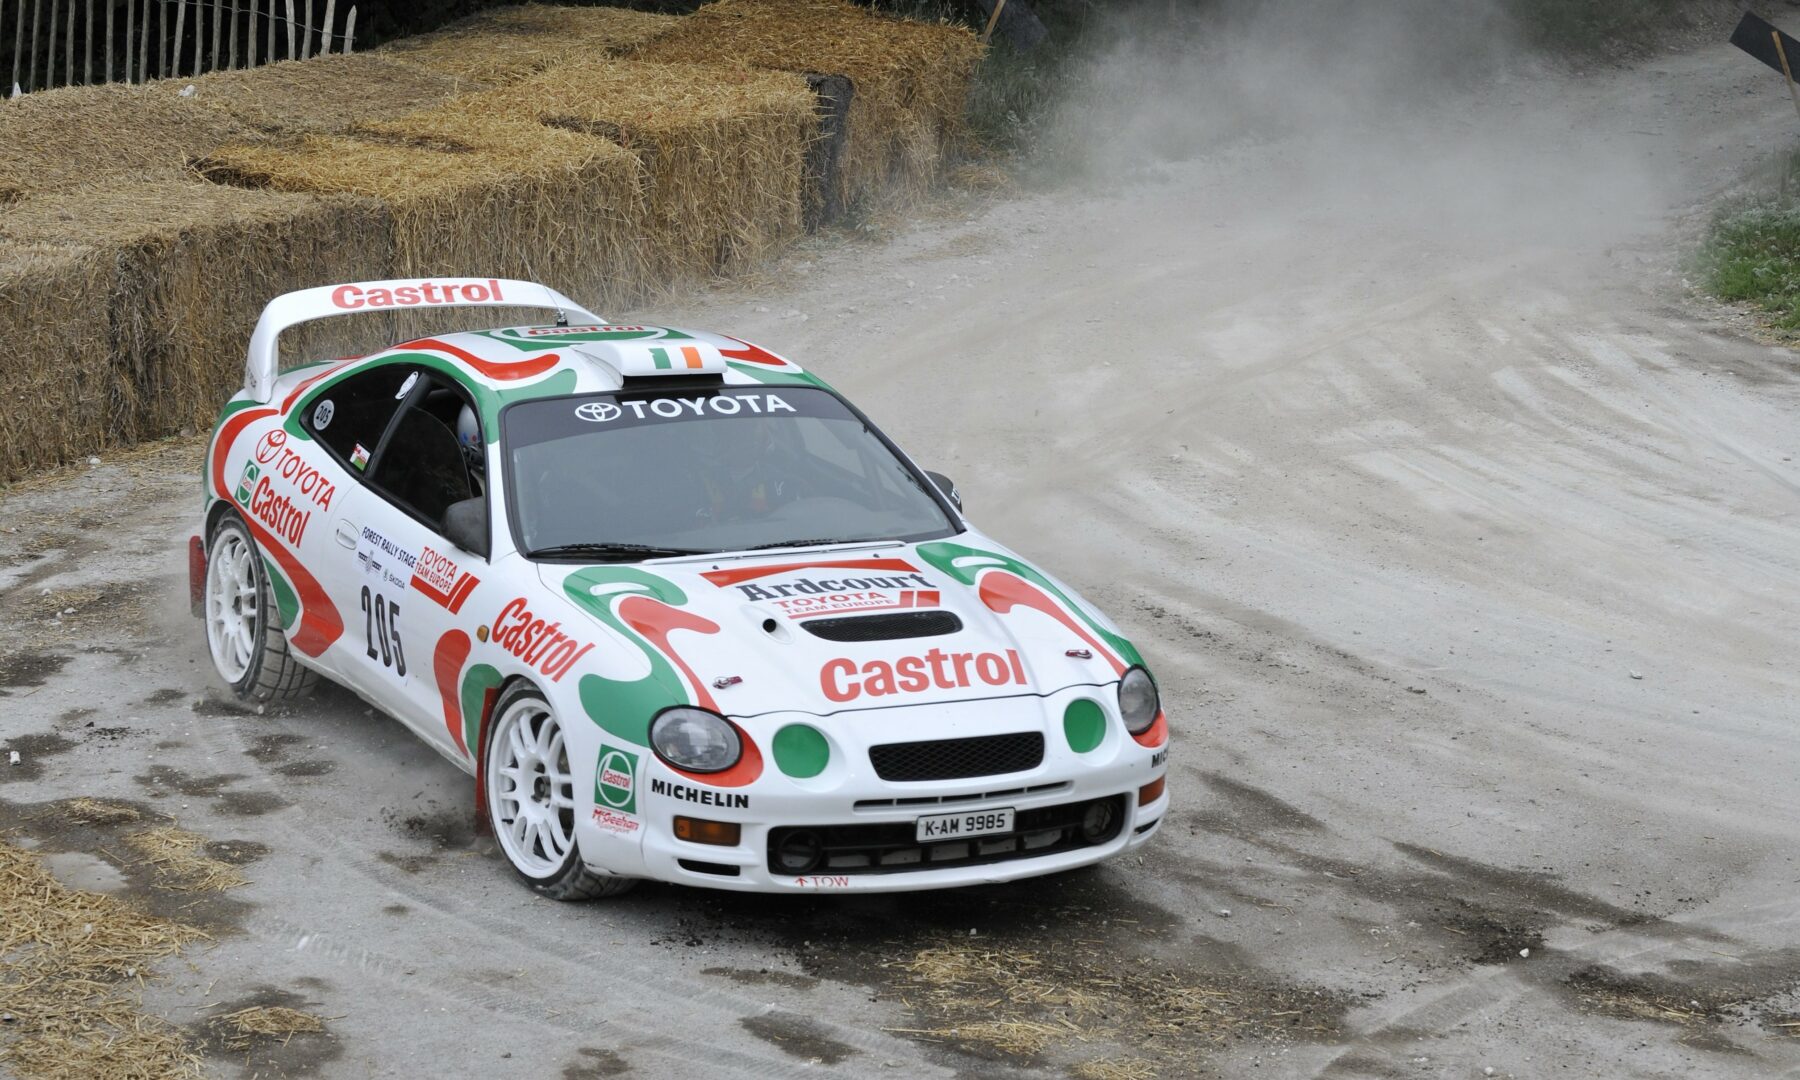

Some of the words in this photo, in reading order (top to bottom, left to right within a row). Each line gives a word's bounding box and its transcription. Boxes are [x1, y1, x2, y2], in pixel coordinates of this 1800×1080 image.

[331, 279, 504, 309] Castrol
[528, 325, 645, 336] Castrol
[315, 405, 332, 424] 205
[622, 394, 797, 419] TOYOTA
[275, 448, 336, 512] TOYOTA
[251, 475, 311, 549] Castrol
[361, 526, 383, 547] FOREST
[380, 538, 400, 558] RALLY
[397, 549, 417, 569] STAGE
[414, 562, 430, 580] TEAM
[428, 571, 453, 593] EUROPE
[419, 546, 458, 582] TOYOTA
[736, 573, 937, 602] Ardcourt
[773, 591, 888, 609] TOYOTA
[783, 604, 828, 615] TEAM
[830, 599, 896, 611] EUROPE
[361, 584, 407, 678] 205
[492, 597, 596, 684] Castrol
[819, 647, 1028, 703] Castrol
[602, 769, 632, 789] Castrol
[652, 778, 749, 809] MICHELIN
[925, 818, 960, 836] K-AM
[965, 813, 1006, 832] 9985
[810, 876, 849, 888] TOW
